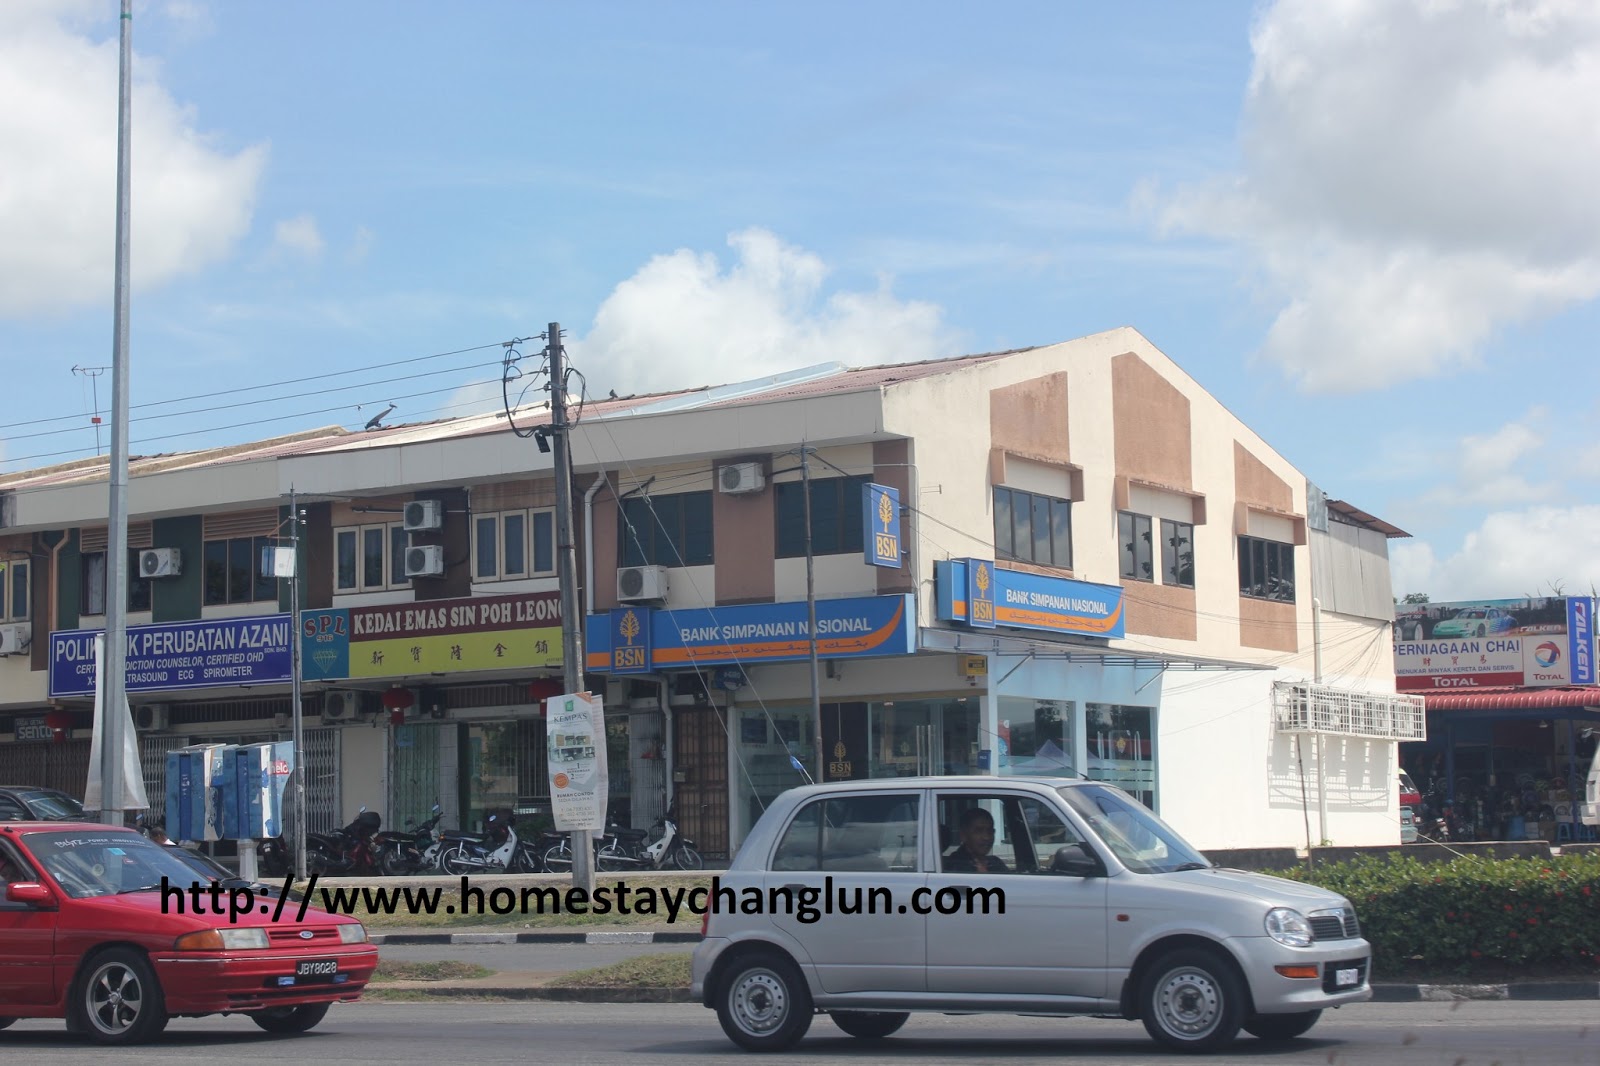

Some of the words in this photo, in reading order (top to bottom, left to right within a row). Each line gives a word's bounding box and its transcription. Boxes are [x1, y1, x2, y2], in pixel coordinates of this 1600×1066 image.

[876, 535, 897, 559] BSN
[1006, 589, 1029, 605] BANK
[1030, 592, 1070, 611] SIMPANAN
[1071, 598, 1109, 615] NASIONAL
[353, 611, 402, 635] KEDAI
[404, 607, 447, 631] EMAS
[450, 605, 476, 627] SIN
[480, 602, 512, 625] POH
[973, 603, 993, 621] BSN
[304, 615, 346, 637] SPL
[681, 626, 719, 642] BANK
[722, 623, 795, 641] SIMPANAN
[1520, 624, 1561, 632] FALKEN
[56, 634, 139, 662] POLIKK
[143, 627, 235, 656] PERUBATAN
[238, 622, 288, 648] AZANI
[316, 634, 333, 642] 916
[1486, 640, 1519, 653] CHAI
[1574, 601, 1589, 680] FALKEN
[125, 660, 155, 671] DICTION
[156, 656, 204, 669] COUNSELOR,
[206, 653, 245, 665] CERTIFIED
[246, 652, 264, 663] OHD
[614, 649, 645, 668] BSN
[178, 669, 194, 680] ECG
[203, 665, 252, 679] SPIROMETER
[1432, 676, 1478, 687] TOTAL
[1533, 673, 1564, 681] TOTAL
[553, 713, 588, 722] KEMPAS
[829, 763, 851, 772] BSN
[297, 962, 337, 975] JBY8028
